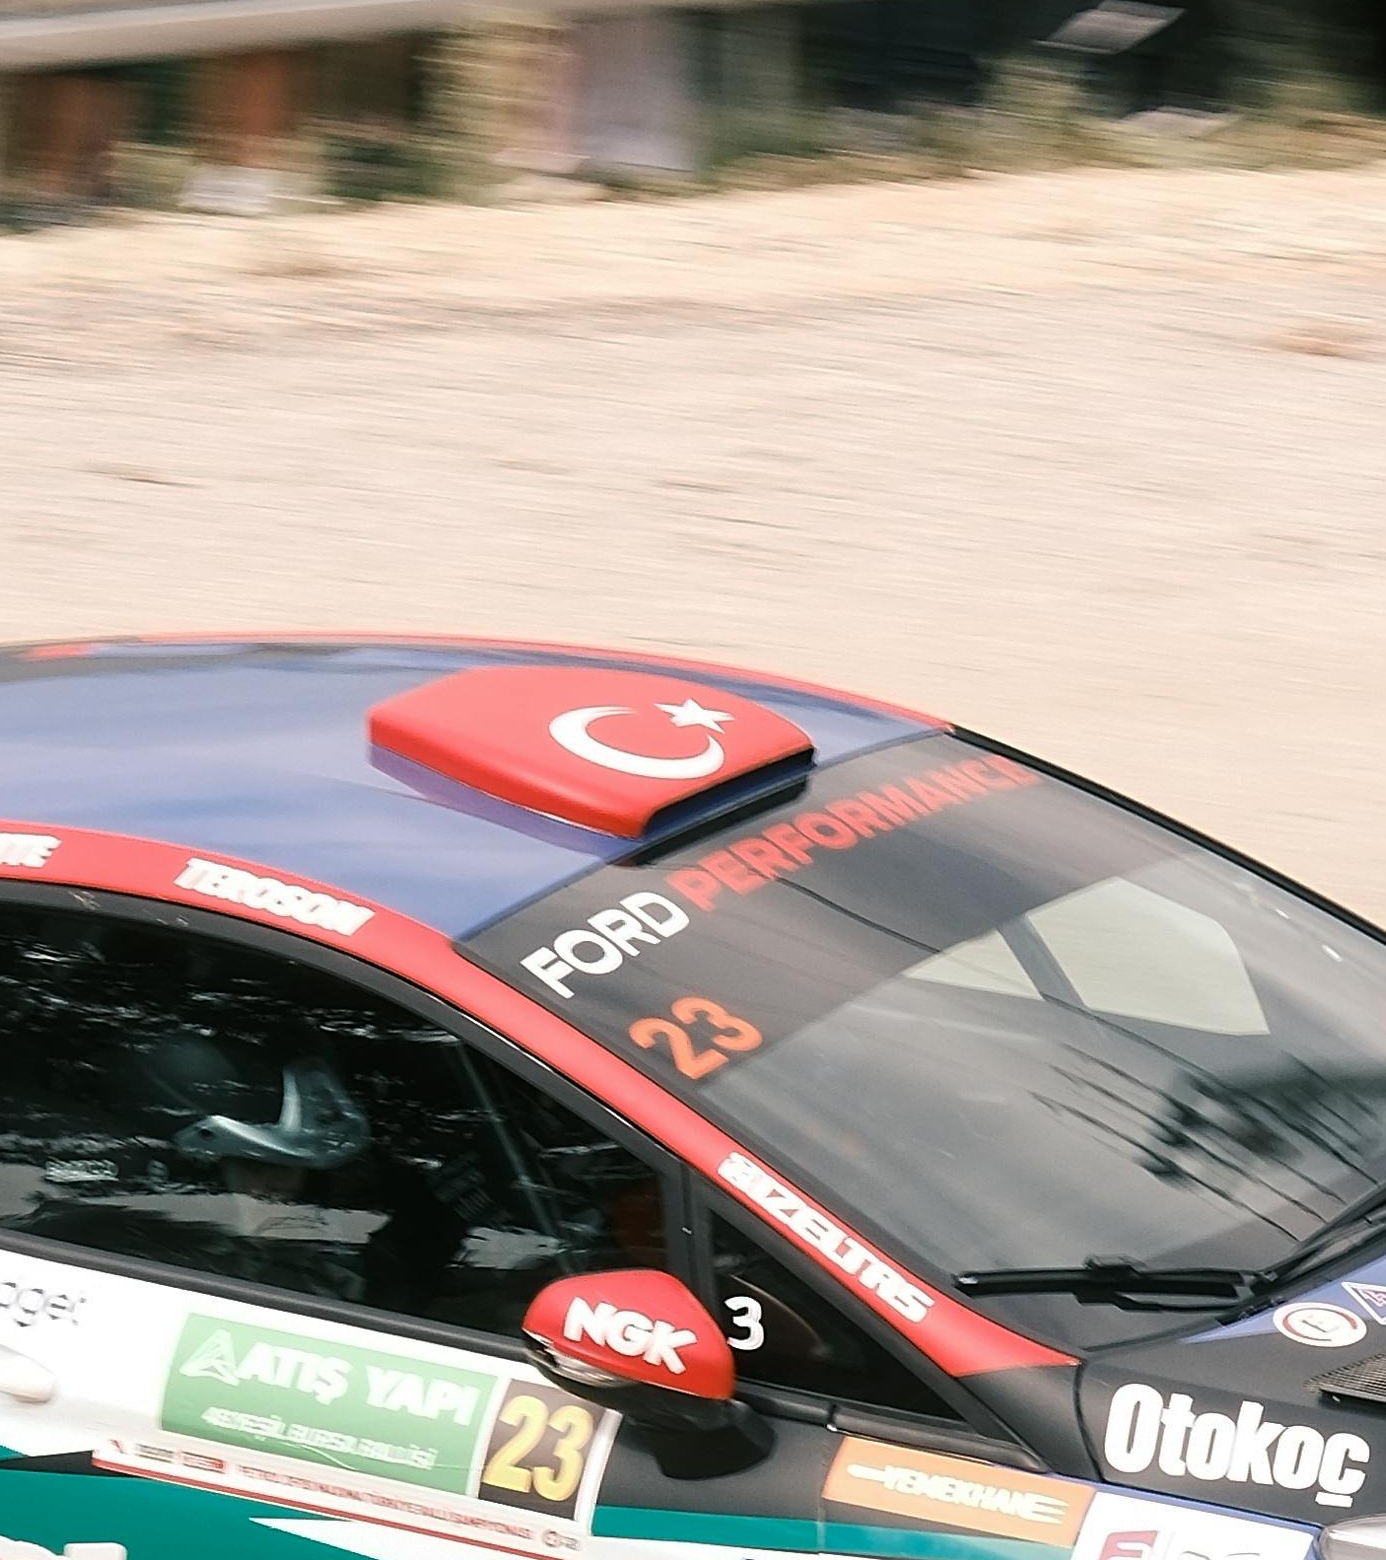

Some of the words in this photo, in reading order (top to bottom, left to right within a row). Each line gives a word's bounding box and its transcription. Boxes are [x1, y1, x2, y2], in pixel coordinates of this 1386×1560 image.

[520, 892, 690, 998] FORD
[667, 754, 1043, 912] PERFORMANCE
[629, 996, 763, 1080] 23
[563, 1296, 698, 1375] NGK
[365, 1364, 484, 1426] YAPI
[481, 1395, 595, 1502] 23
[1104, 1383, 1371, 1508] Otokoç
